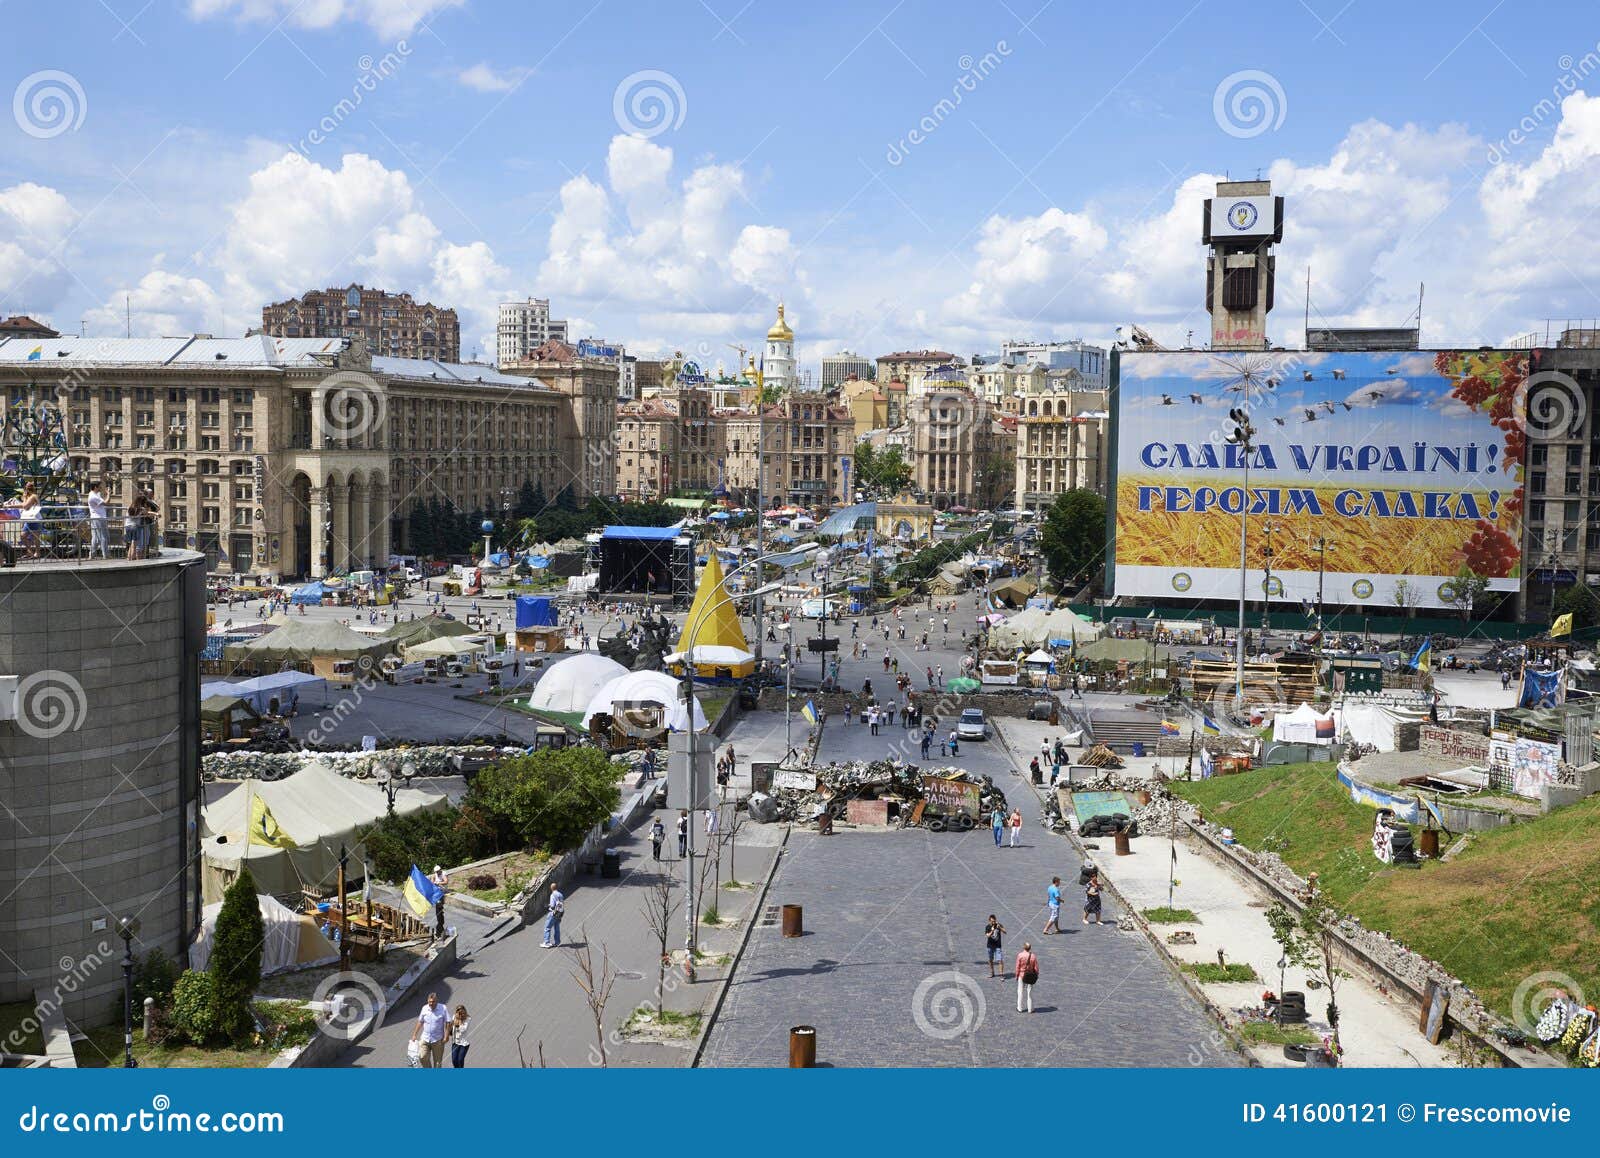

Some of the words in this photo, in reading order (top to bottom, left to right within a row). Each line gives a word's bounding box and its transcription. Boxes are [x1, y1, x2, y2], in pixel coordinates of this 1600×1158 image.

[1140, 441, 1279, 472] СЛАВА
[1290, 442, 1499, 474] УКРАЇНІ!
[1137, 485, 1324, 517] ГЕРОЯМ
[1334, 488, 1500, 520] СЛАВА!
